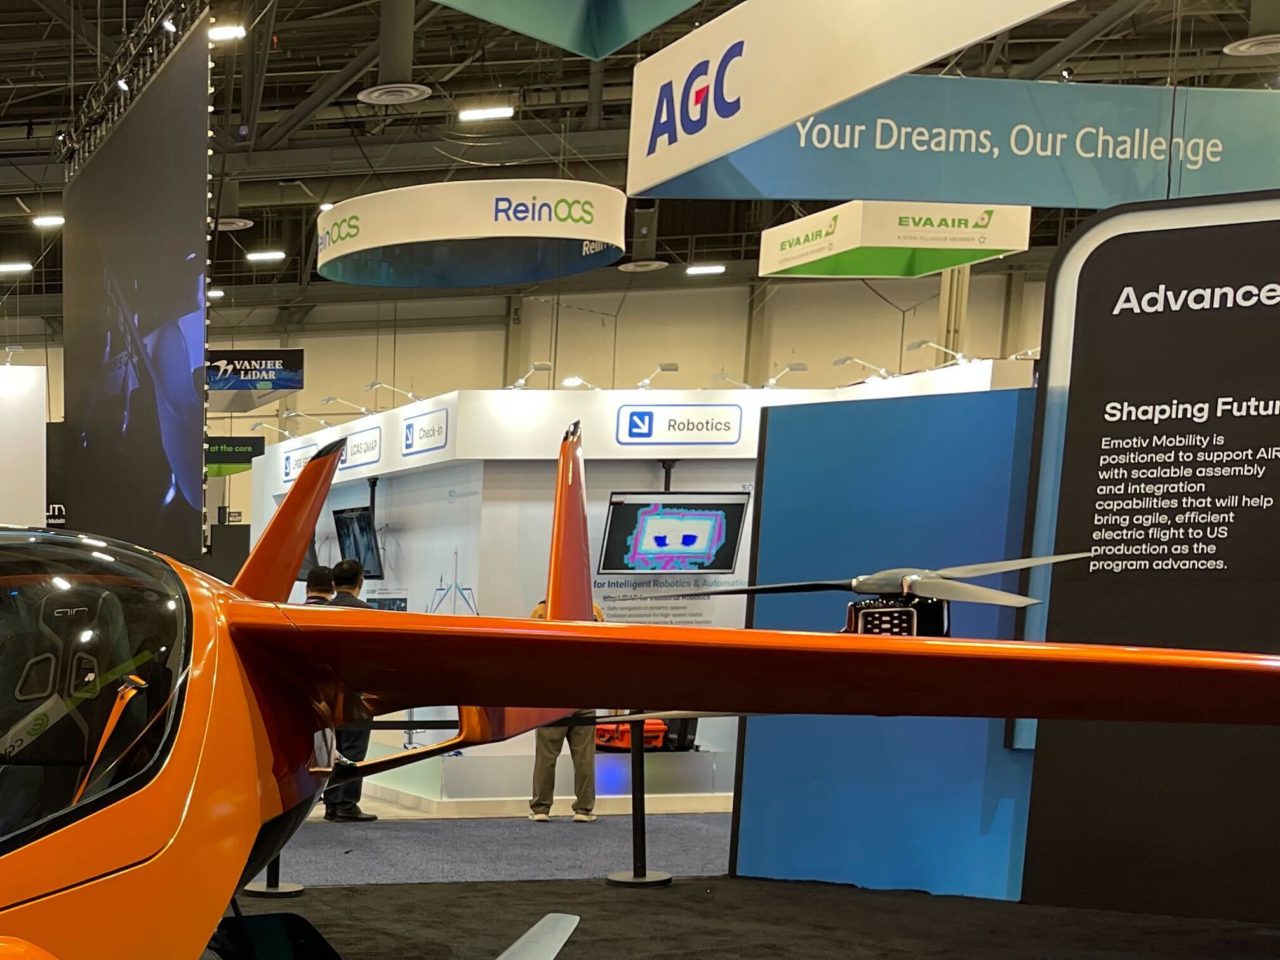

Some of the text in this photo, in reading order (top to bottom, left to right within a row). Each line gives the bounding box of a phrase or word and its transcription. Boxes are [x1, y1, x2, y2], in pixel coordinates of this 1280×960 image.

[646, 40, 745, 156] AGC
[794, 115, 1224, 171] Your Dreams, Our Challenge
[1112, 284, 1280, 316] Advance
[233, 360, 284, 370] VANJEE
[239, 370, 276, 380] LiDAR
[1104, 399, 1210, 425] Shaping
[667, 418, 732, 432] Robotics
[210, 444, 219, 452] at
[220, 444, 234, 452] the
[1101, 433, 1225, 450] Emotiv Mobility is
[1099, 450, 1175, 466] positioned
[1177, 451, 1194, 462] to
[1196, 448, 1253, 464] support
[1098, 463, 1266, 480] with scalable assembly
[1096, 481, 1206, 496] and integration
[1095, 494, 1274, 512] capabilities that will help
[1094, 510, 1235, 527] bring agile, efficient
[1092, 526, 1229, 542] electric flight to US
[1091, 542, 1217, 558] production as the
[1089, 557, 1228, 573] program advances.
[593, 580, 606, 589] for
[608, 579, 651, 590] Intelligent
[653, 579, 691, 588] Robotics
